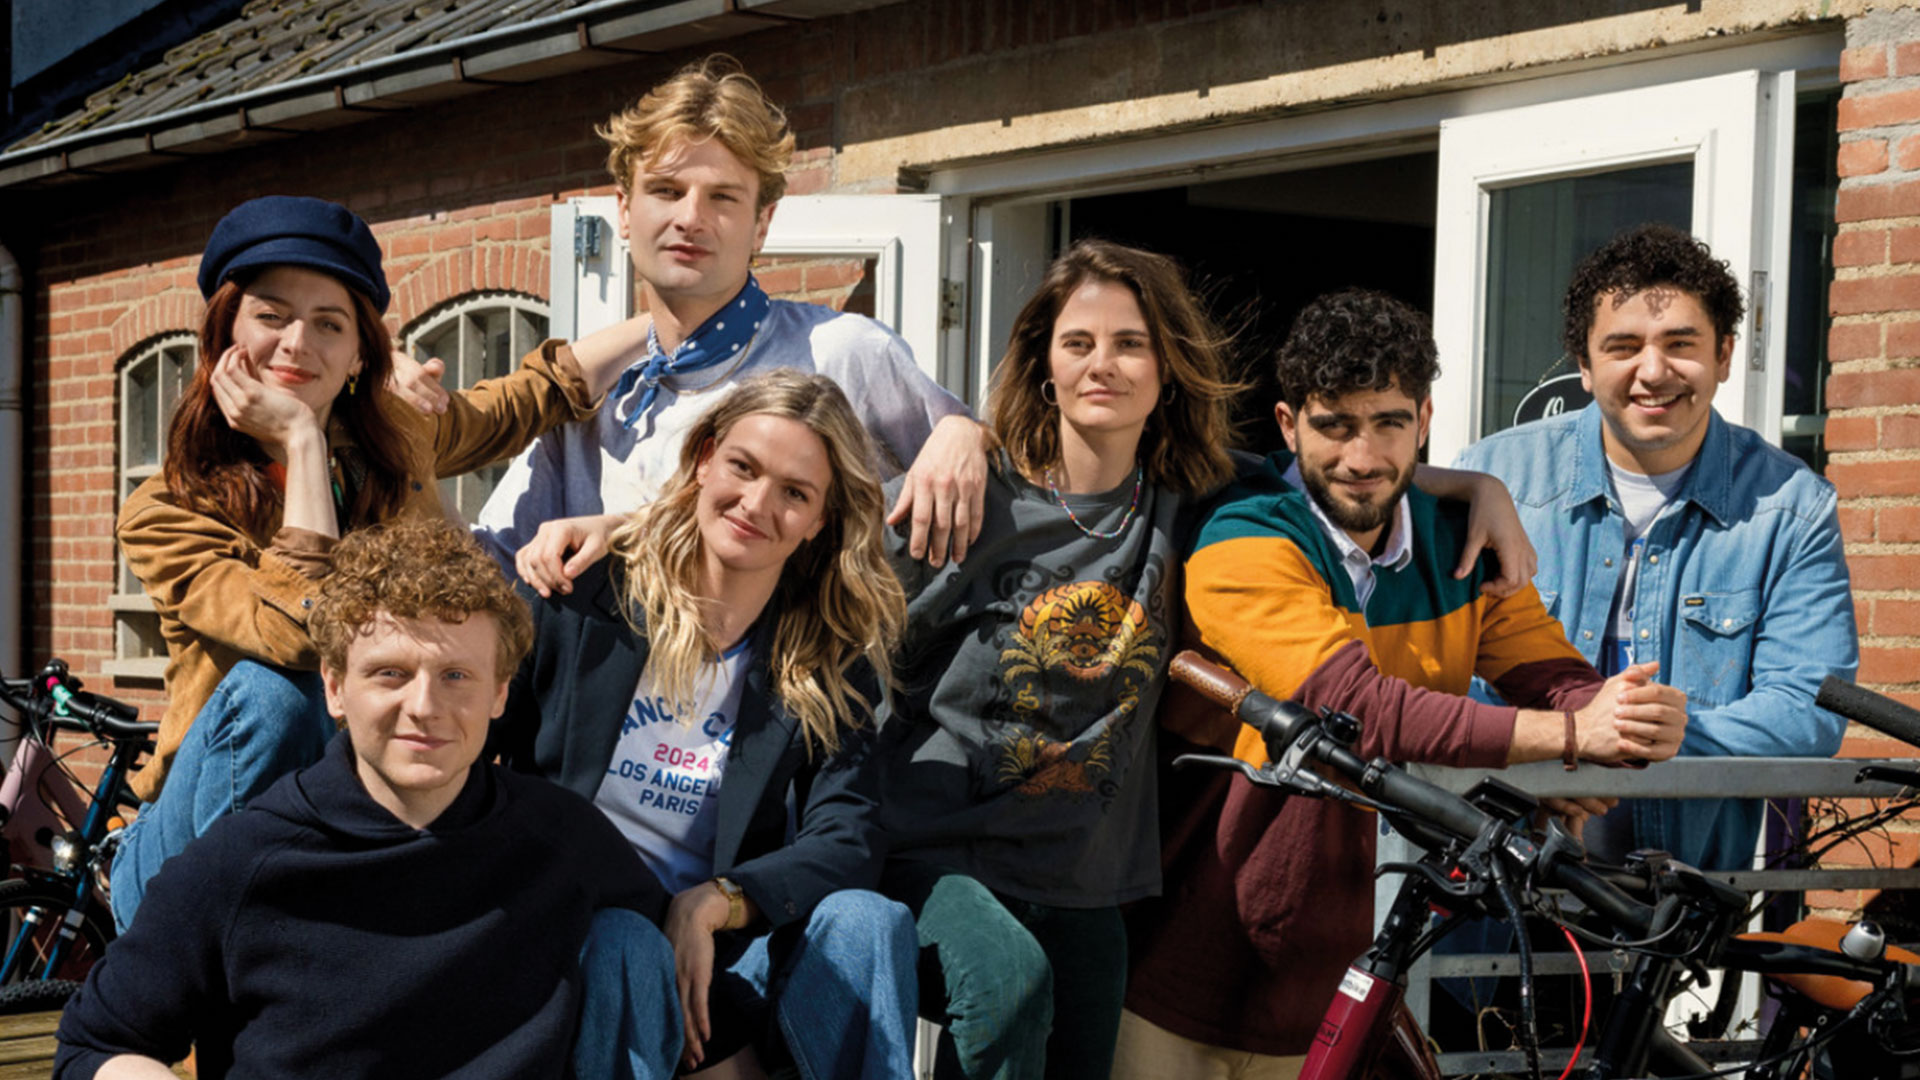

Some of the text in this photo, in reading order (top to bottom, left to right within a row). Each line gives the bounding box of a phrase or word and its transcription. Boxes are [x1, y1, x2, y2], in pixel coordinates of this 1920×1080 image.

[653, 743, 709, 772] 2024
[650, 768, 717, 798] ANGEL
[638, 788, 699, 815] PARIS
